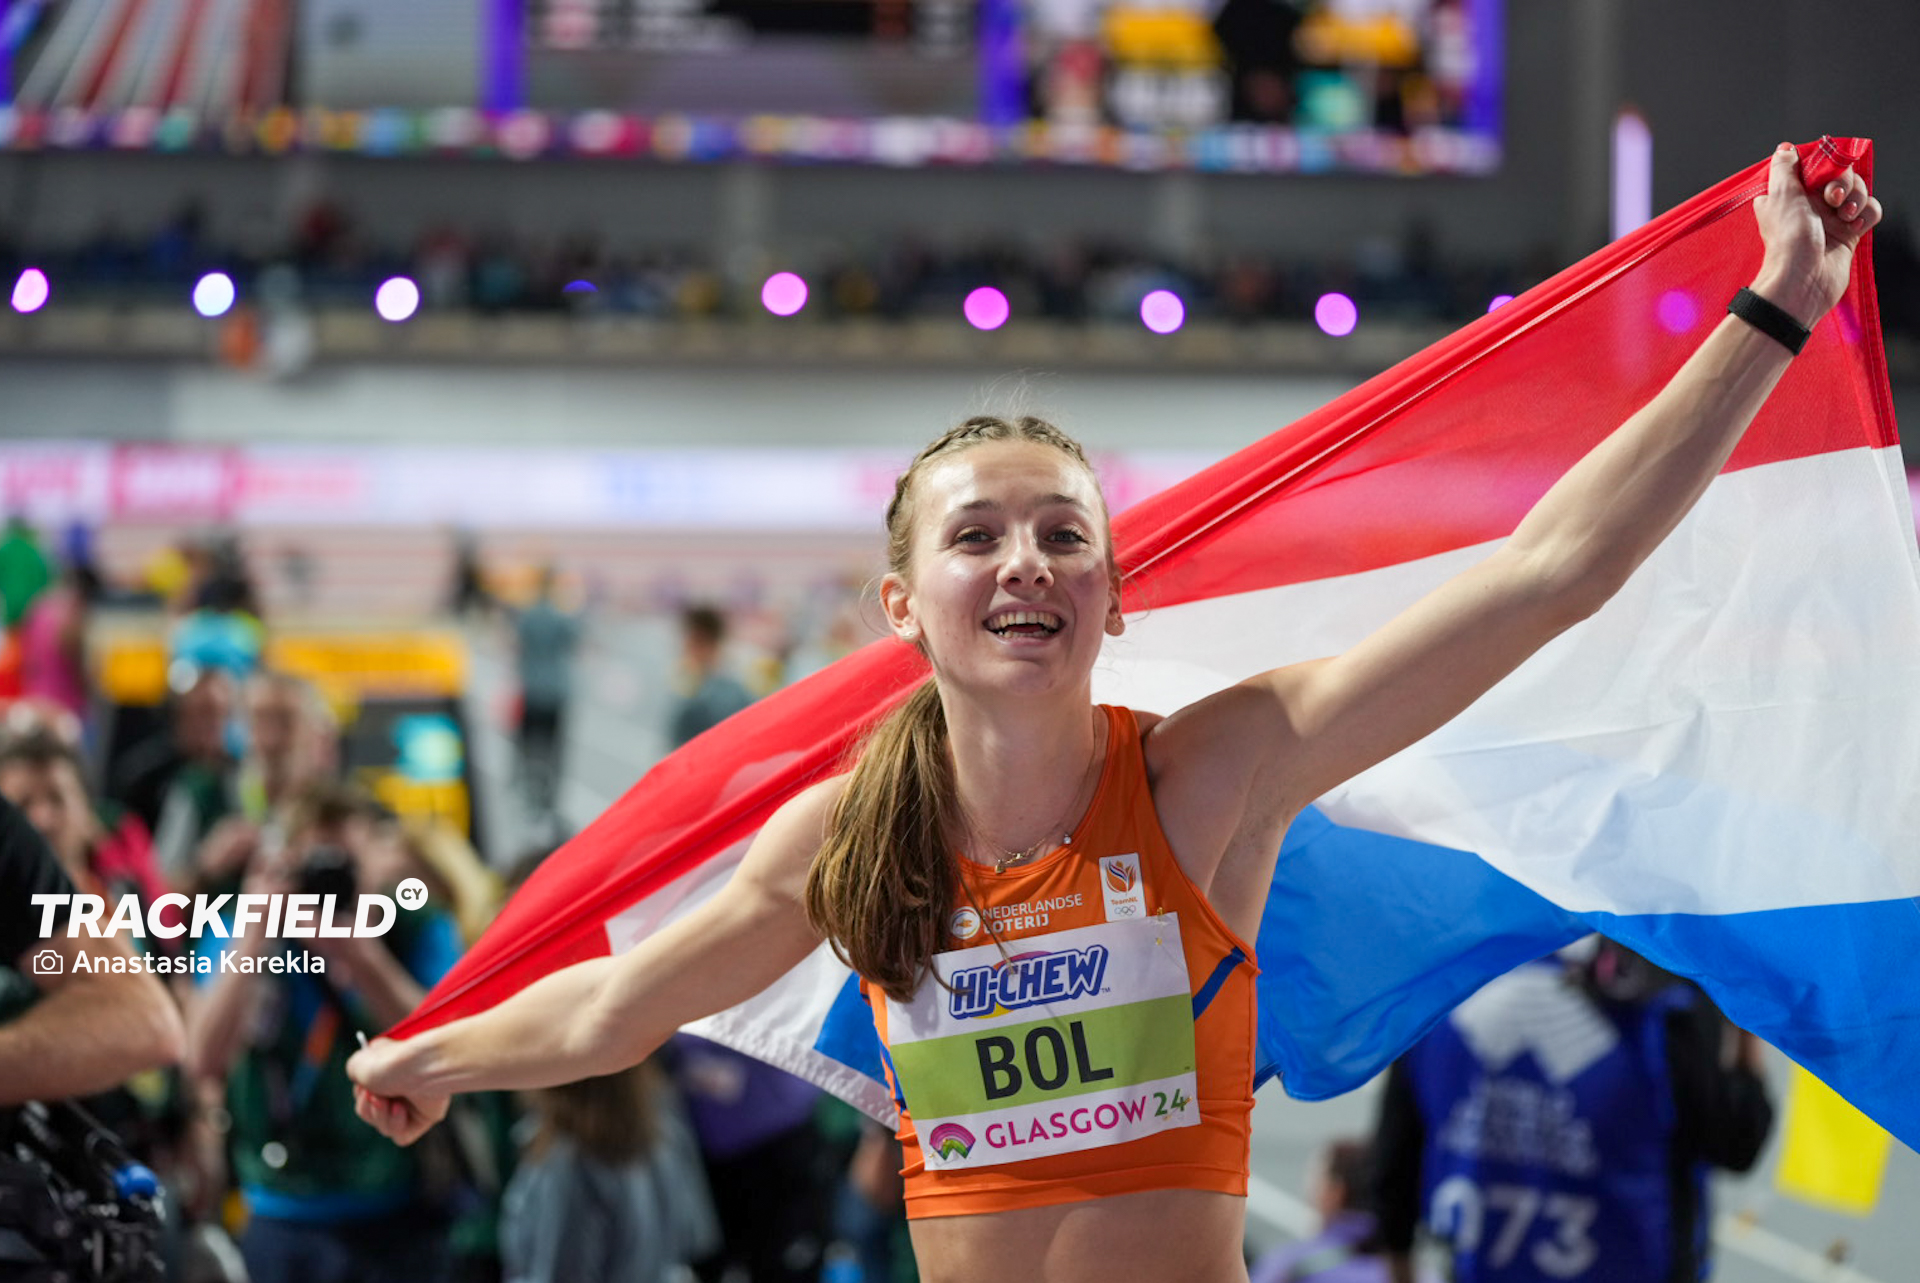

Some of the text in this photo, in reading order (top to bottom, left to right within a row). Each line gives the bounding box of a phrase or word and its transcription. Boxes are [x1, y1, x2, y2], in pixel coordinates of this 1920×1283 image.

[983, 894, 1083, 919] NEDERLANDSE
[984, 913, 1050, 935] LOTERIJ
[950, 944, 1108, 1019] HI-CHEW
[976, 1021, 1114, 1100] BOL
[985, 1089, 1187, 1148] GLASGOW 24
